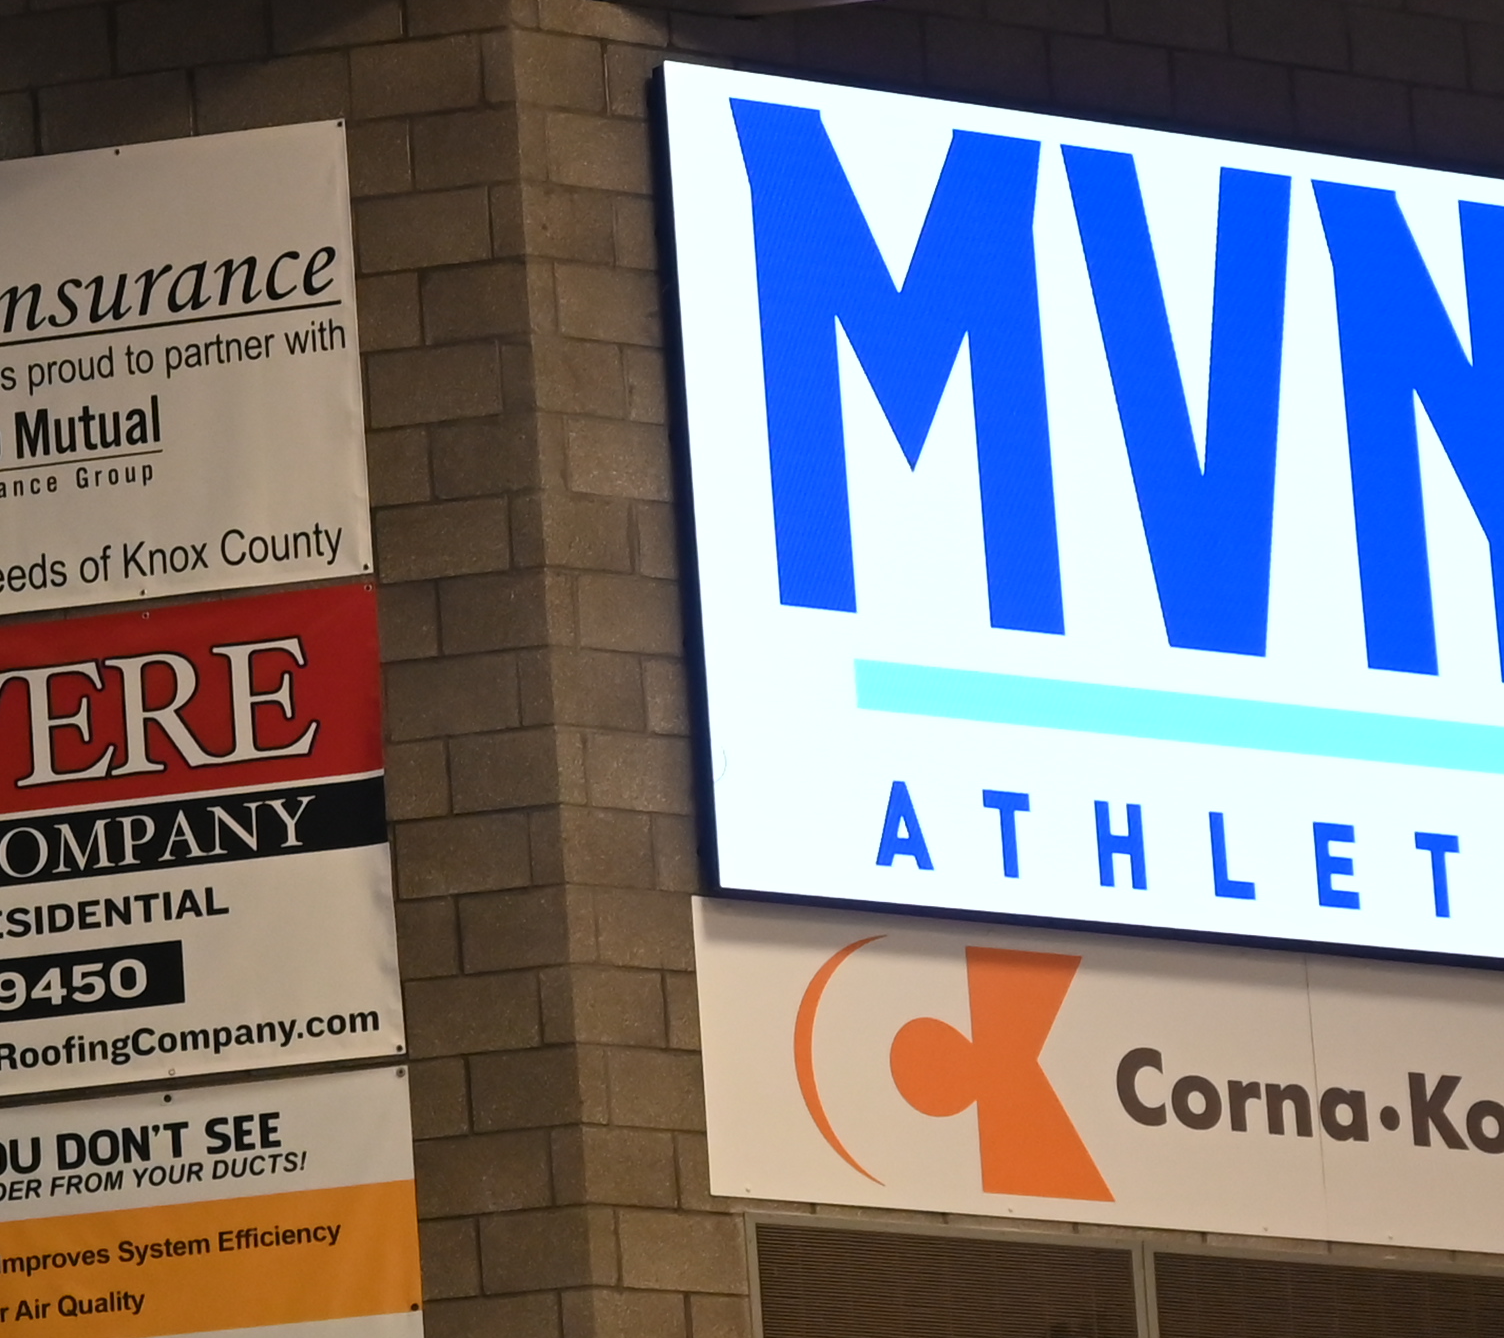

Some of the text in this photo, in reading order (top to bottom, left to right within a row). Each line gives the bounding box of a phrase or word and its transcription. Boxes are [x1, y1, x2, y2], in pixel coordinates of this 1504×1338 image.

[27, 347, 116, 398] proud
[125, 346, 156, 378] to
[164, 330, 275, 380] partner
[286, 317, 348, 360] with
[13, 394, 163, 461] Mutual
[76, 459, 157, 493] Group
[78, 544, 114, 586] of
[122, 536, 210, 579] Knox
[219, 521, 344, 571] County
[204, 1110, 283, 1155] SEE
[48, 1168, 126, 1200] FROM
[131, 1160, 206, 1190] YOUR
[210, 1150, 309, 1182] DUCTS!
[116, 1234, 212, 1270] System
[217, 1221, 343, 1258] Efficiency
[13, 1298, 51, 1324] Air
[57, 1289, 147, 1321] Quality
